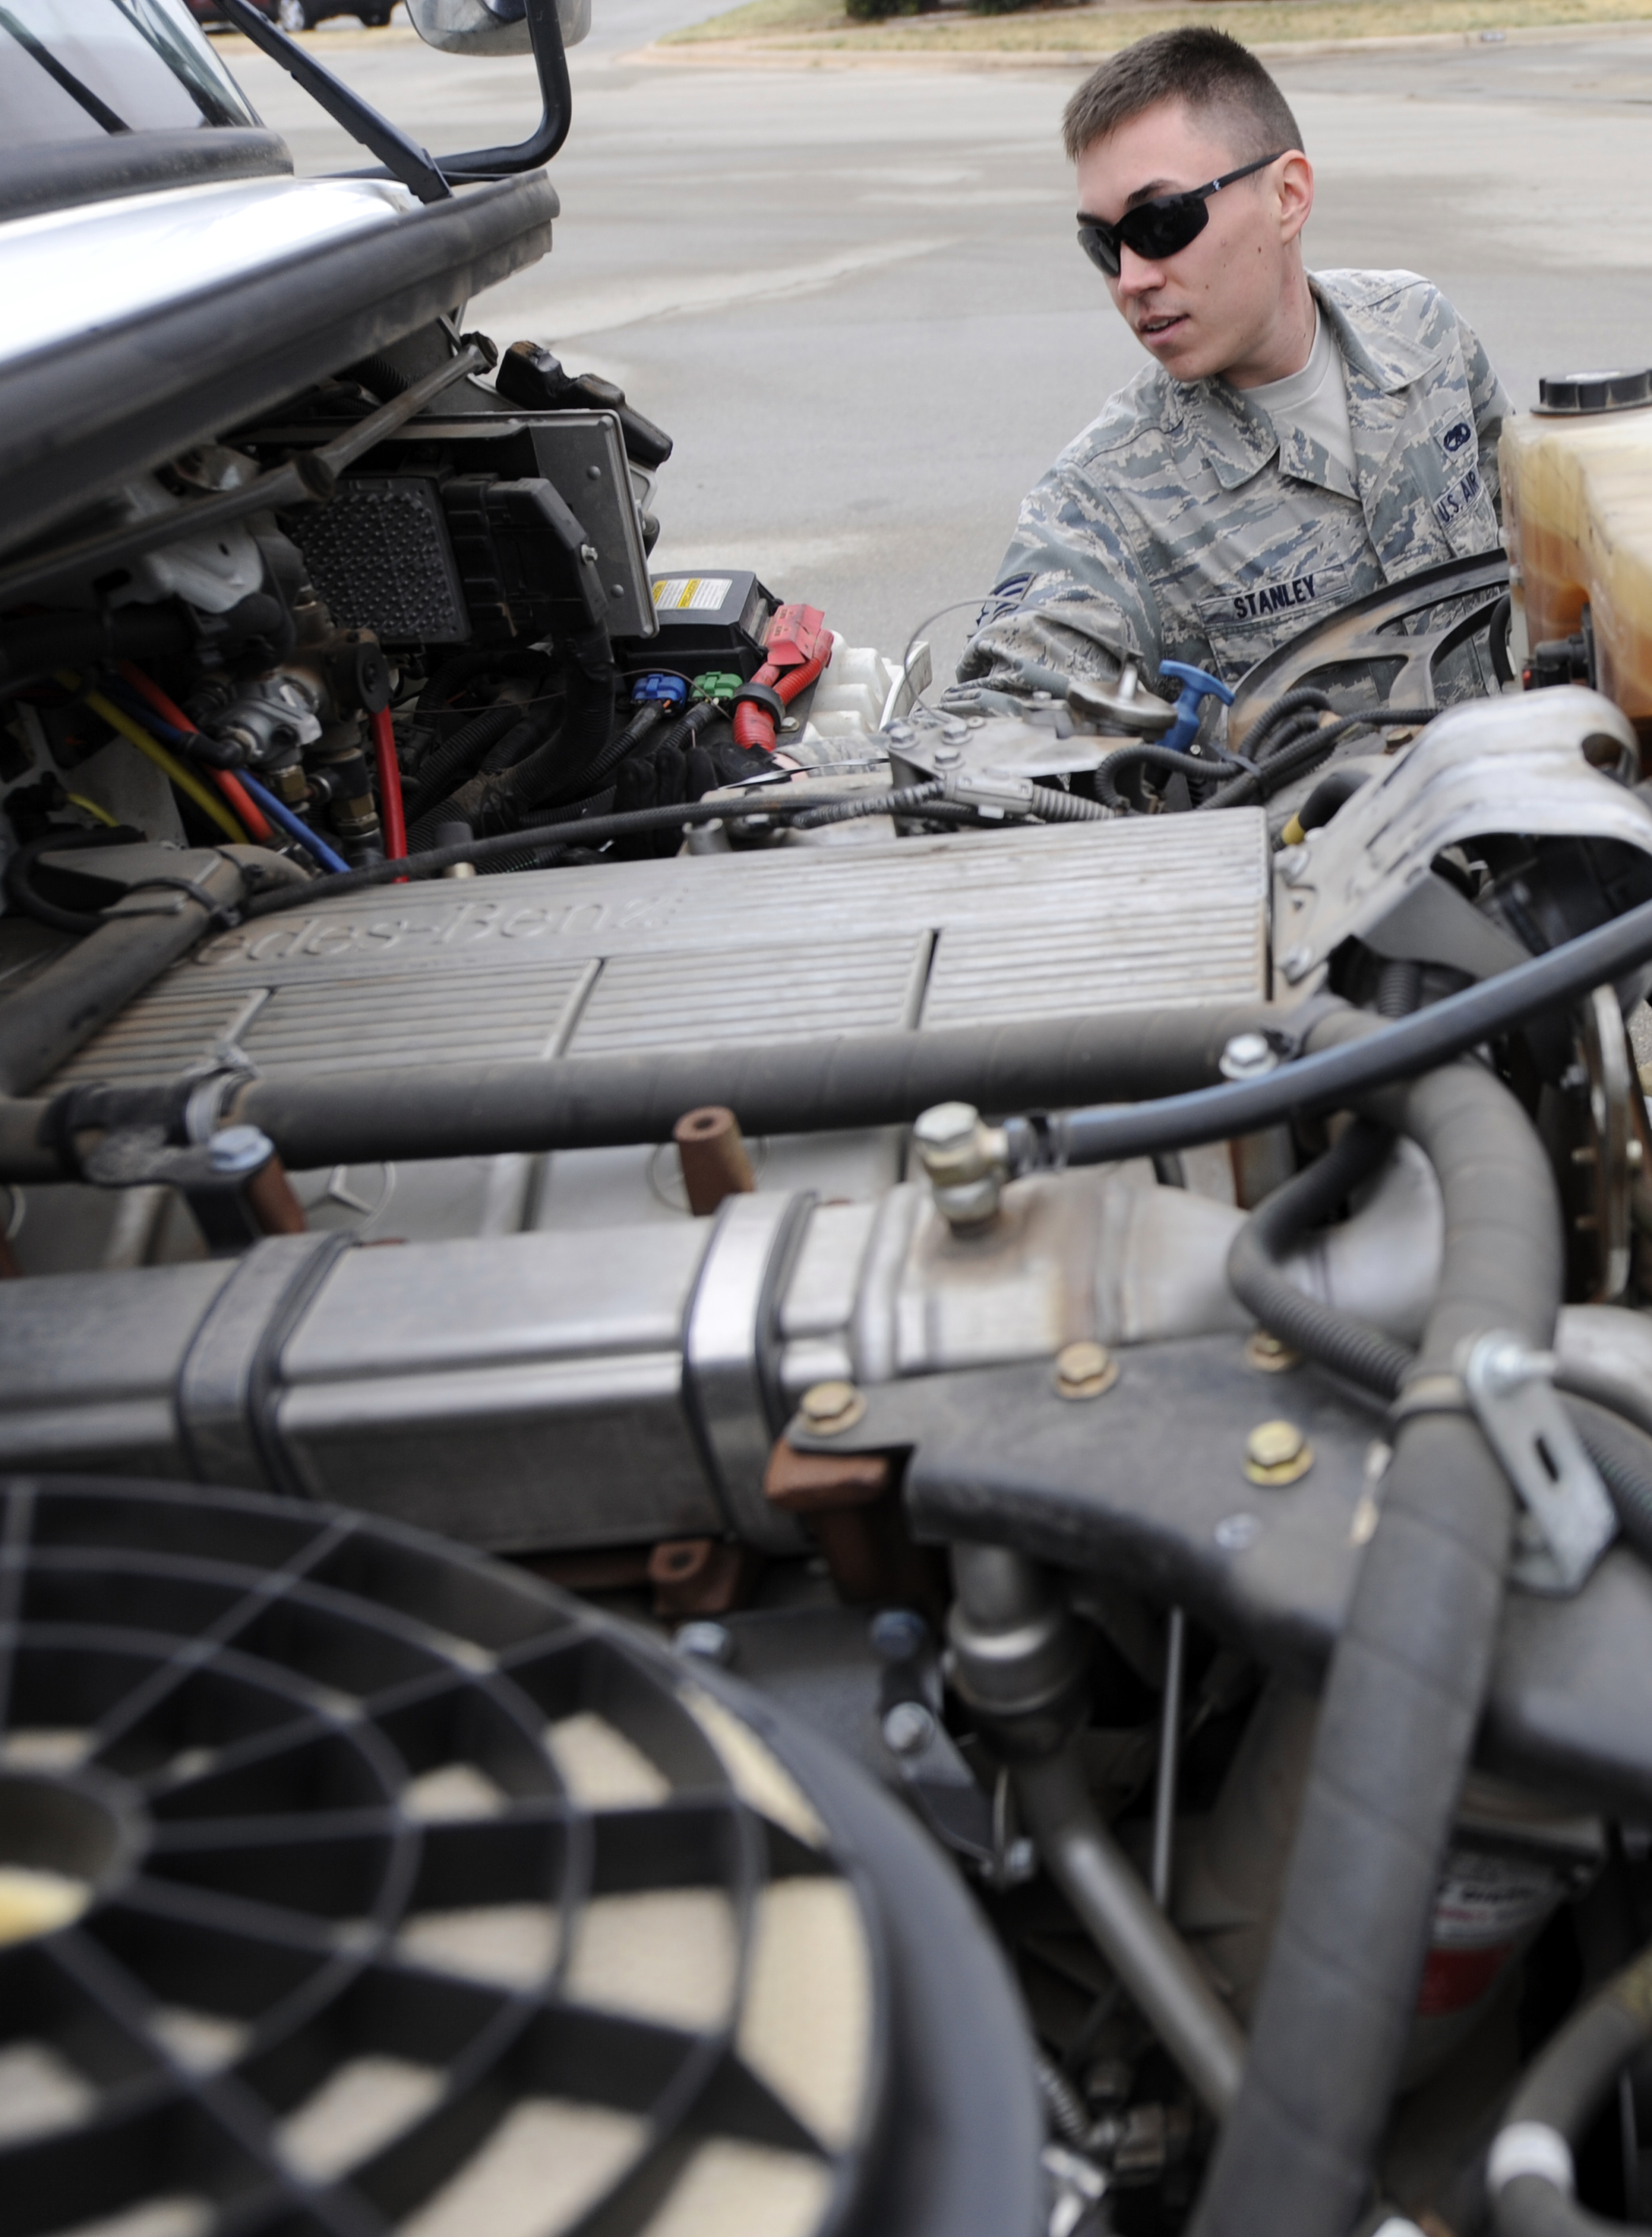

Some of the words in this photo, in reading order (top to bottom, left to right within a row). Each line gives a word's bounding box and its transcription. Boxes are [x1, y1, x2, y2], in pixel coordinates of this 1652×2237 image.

[1437, 494, 1463, 522] U.S.
[1460, 471, 1479, 503] AIR
[1233, 574, 1316, 618] STANLEY
